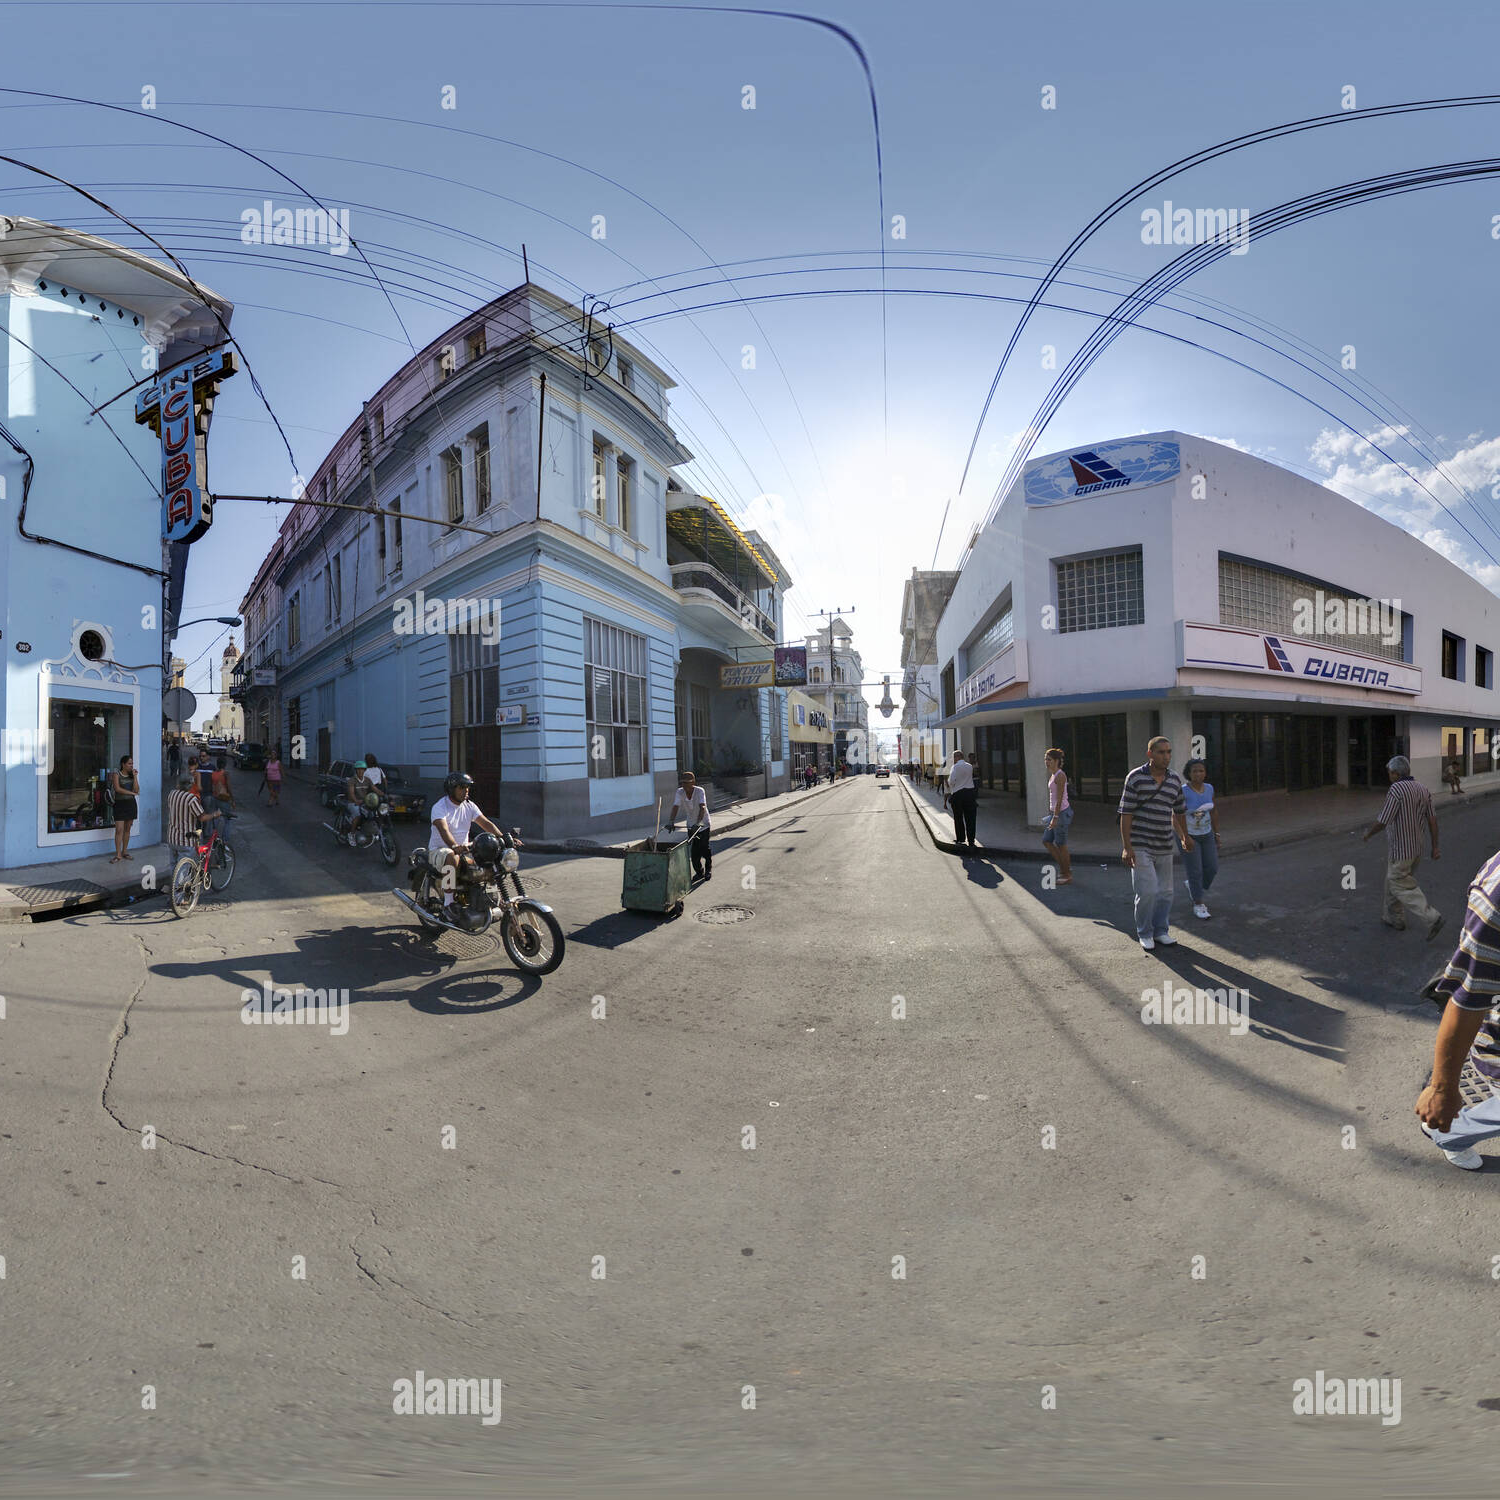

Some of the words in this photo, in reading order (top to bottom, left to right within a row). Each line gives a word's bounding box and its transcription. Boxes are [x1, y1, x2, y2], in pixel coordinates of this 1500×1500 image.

[139, 357, 213, 408] CINE
[163, 390, 193, 535] CUBA
[1074, 478, 1132, 496] CUBANA
[1303, 657, 1390, 687] CUBANA
